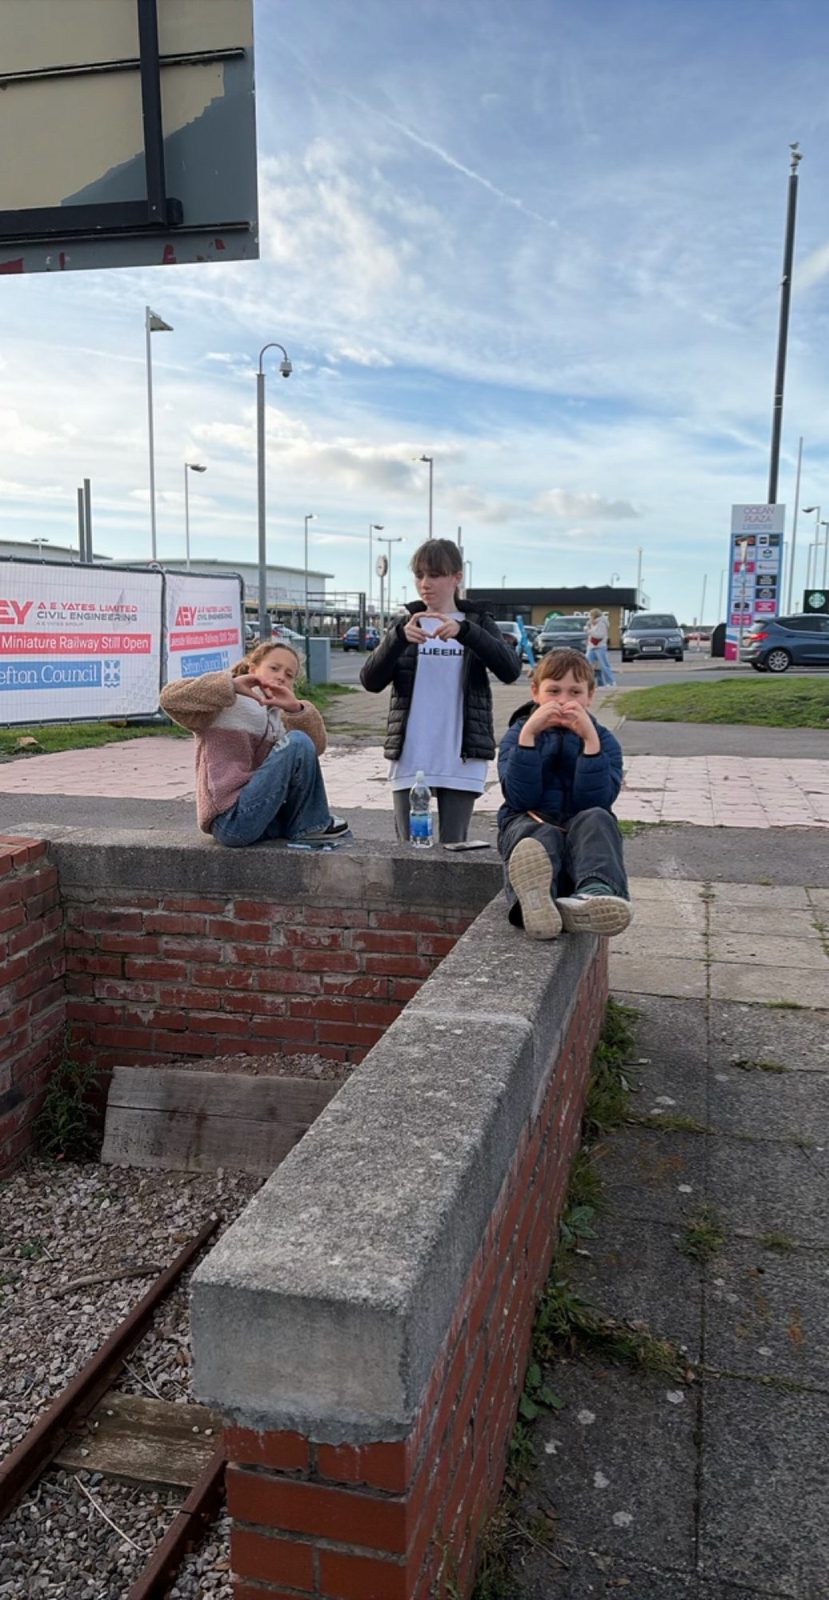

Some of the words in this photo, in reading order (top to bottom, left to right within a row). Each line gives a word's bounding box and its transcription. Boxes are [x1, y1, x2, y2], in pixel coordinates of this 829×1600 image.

[0, 599, 33, 624] EY
[36, 611, 66, 620] CIVIL
[70, 612, 138, 622] ENGINEERING
[37, 602, 46, 610] A
[50, 602, 57, 610] E
[60, 602, 96, 611] YATES
[99, 604, 138, 613] LIMITED
[175, 606, 197, 626] AEY
[1, 635, 57, 649] Miniature
[59, 636, 99, 652] Railway
[101, 637, 121, 649] Still
[122, 638, 149, 651] Open
[0, 666, 37, 685] efton
[40, 664, 97, 684] Council
